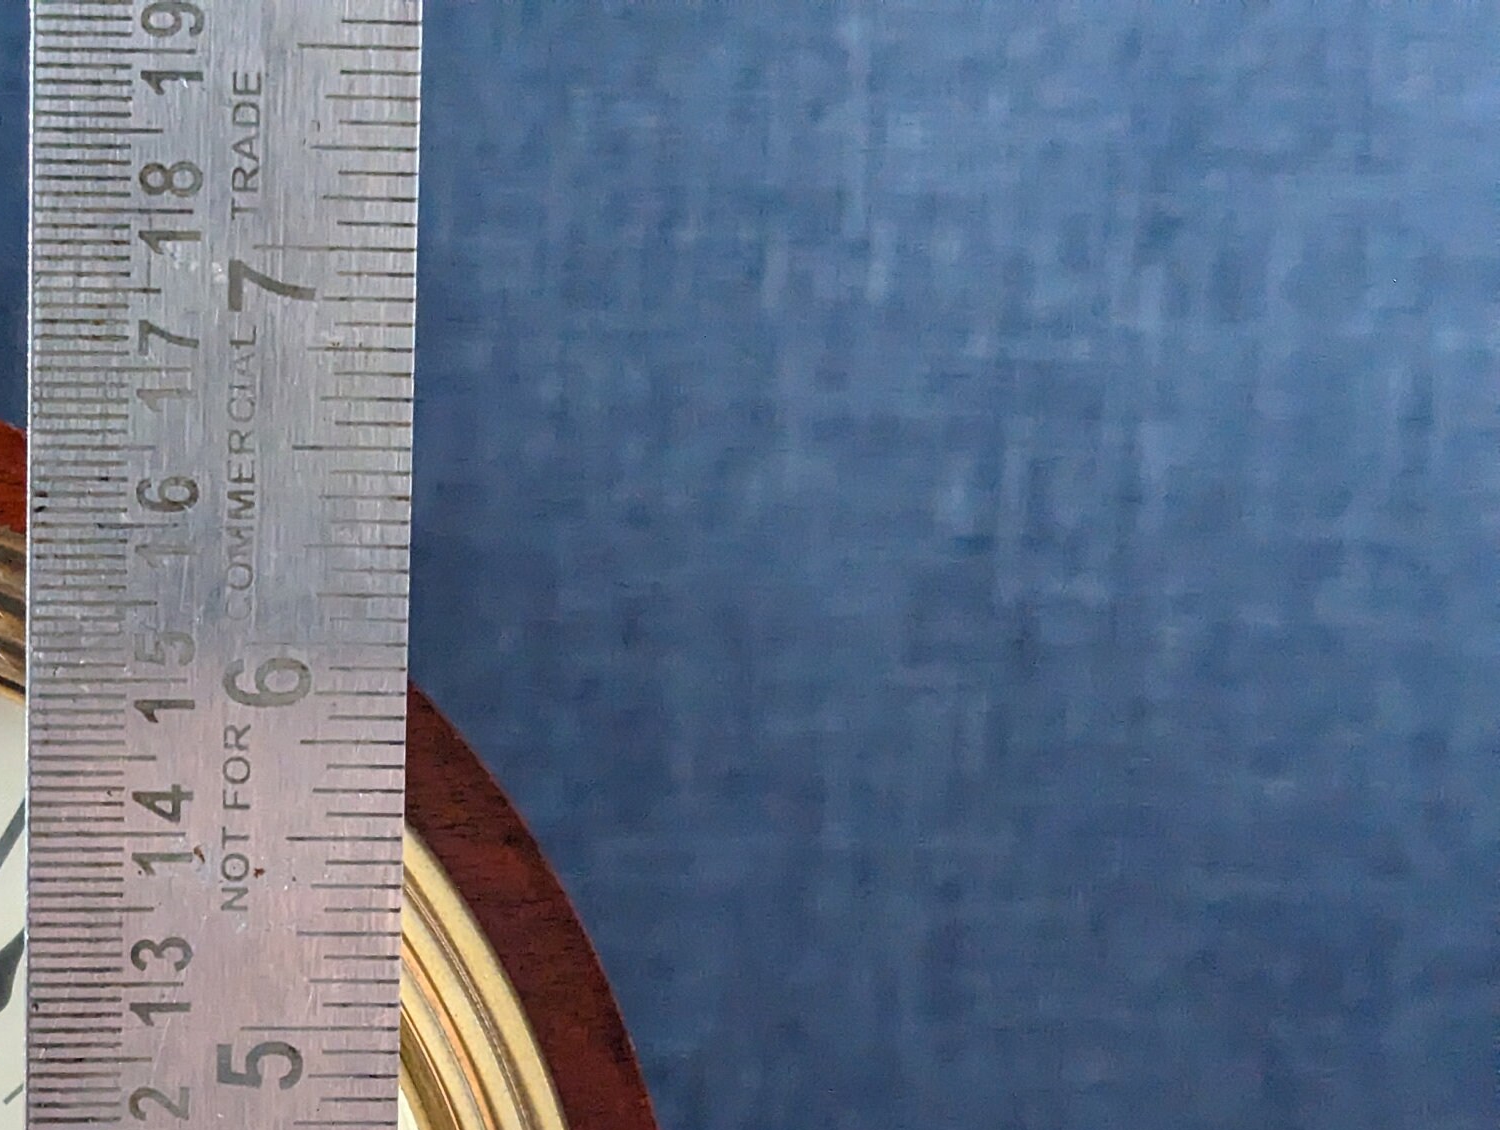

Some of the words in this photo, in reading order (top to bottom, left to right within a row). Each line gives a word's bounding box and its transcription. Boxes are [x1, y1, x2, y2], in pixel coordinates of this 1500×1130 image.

[140, 0, 204, 95] 19
[230, 70, 263, 221] TRADE
[138, 161, 203, 255] 18
[227, 259, 316, 312] 7
[136, 320, 200, 412] 17
[224, 325, 258, 622] COMMERCIAL
[135, 475, 200, 568] 16
[134, 631, 196, 724] 15
[221, 656, 312, 708] 6
[223, 724, 252, 811] FOR
[132, 784, 194, 876] 14
[221, 826, 250, 912] NOT
[130, 936, 194, 1026] 13
[216, 1040, 304, 1090] 5
